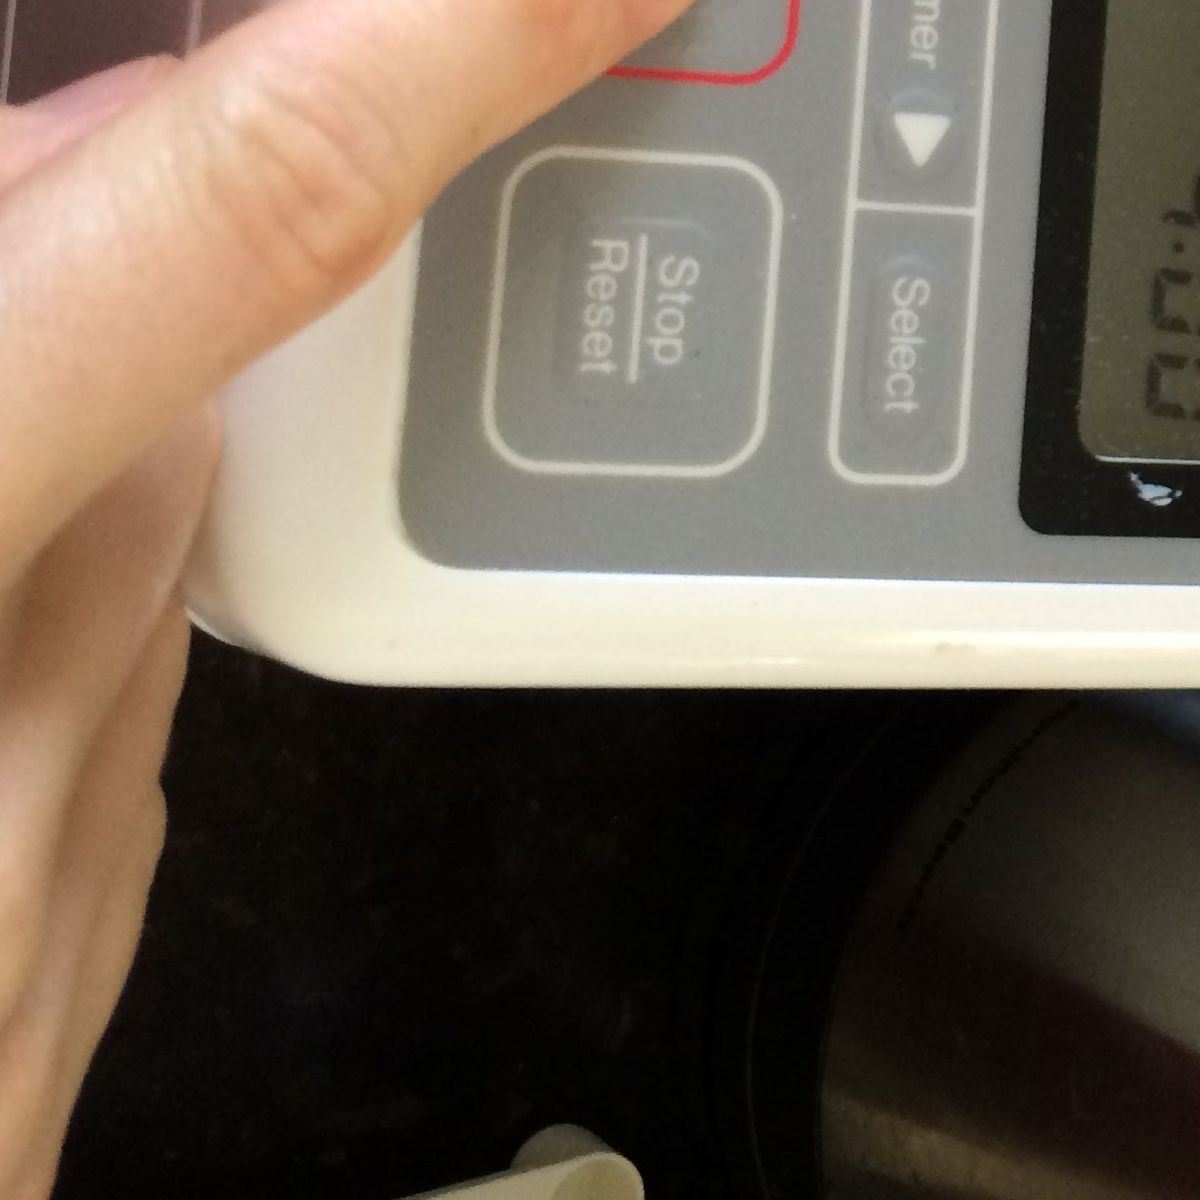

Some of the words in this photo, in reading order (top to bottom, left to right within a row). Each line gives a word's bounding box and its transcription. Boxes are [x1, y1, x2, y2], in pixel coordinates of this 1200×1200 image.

[580, 238, 631, 376] Reset
[648, 255, 700, 367] Stop
[882, 275, 931, 415] Select
